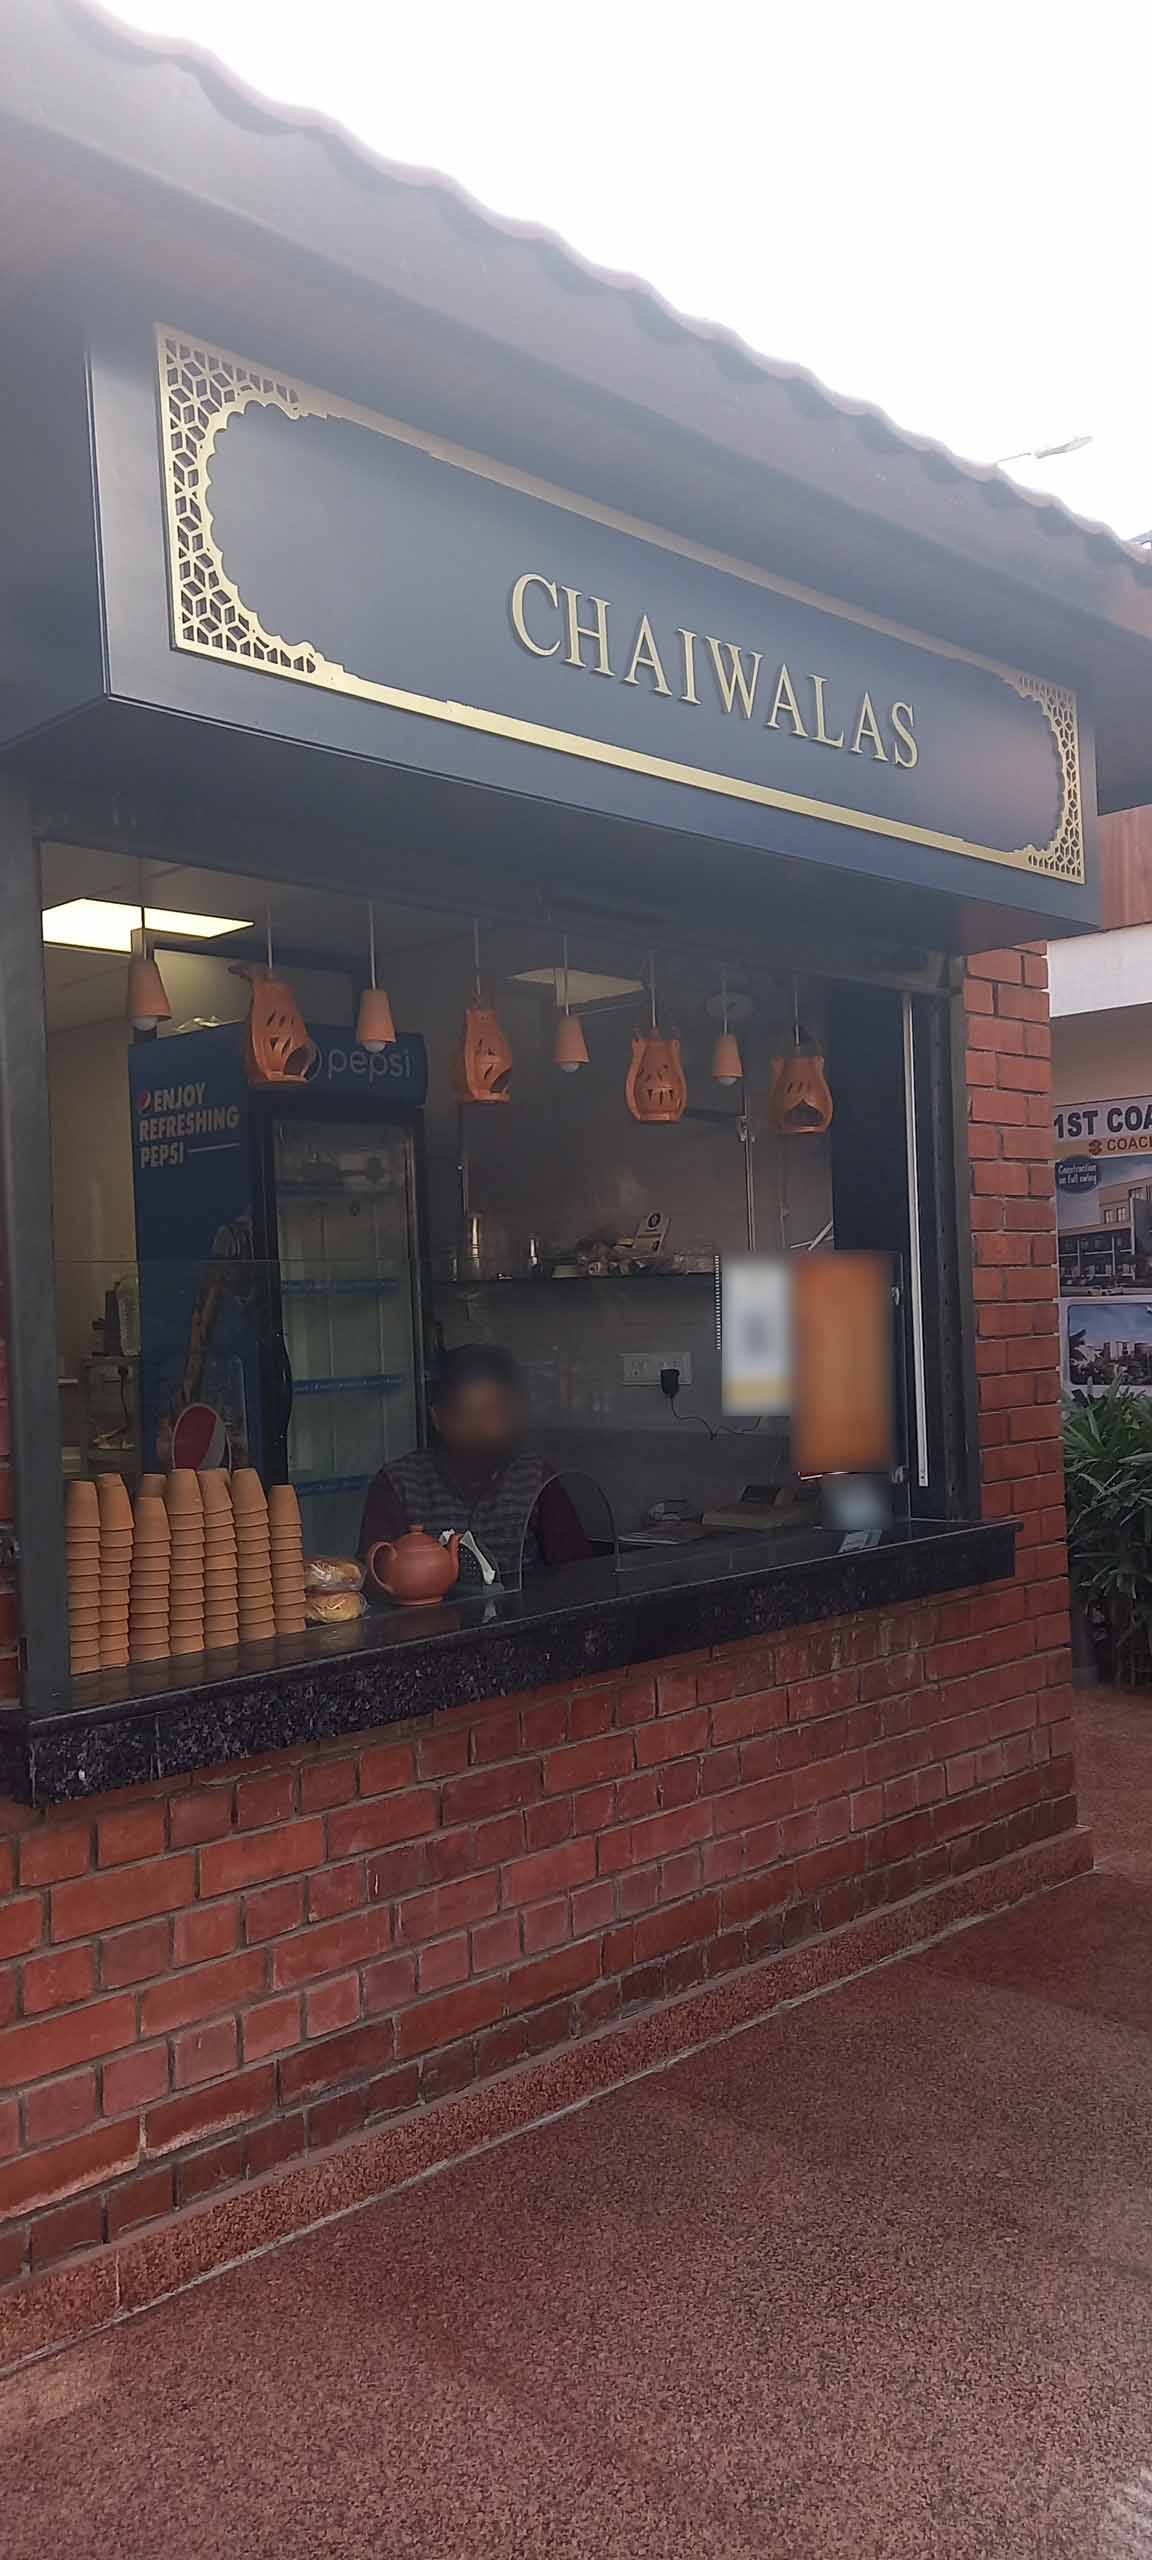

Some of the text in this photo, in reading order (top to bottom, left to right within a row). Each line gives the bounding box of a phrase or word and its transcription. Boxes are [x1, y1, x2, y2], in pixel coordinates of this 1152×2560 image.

[511, 573, 919, 768] CHAIWALAS
[327, 1047, 412, 1085] pepsi
[154, 1082, 206, 1113] ENJOY
[140, 1106, 240, 1142] REFRESHING
[1054, 1110, 1098, 1139] 1ST
[140, 1142, 184, 1169] PEPSI
[1107, 1136, 1152, 1152] COAC
